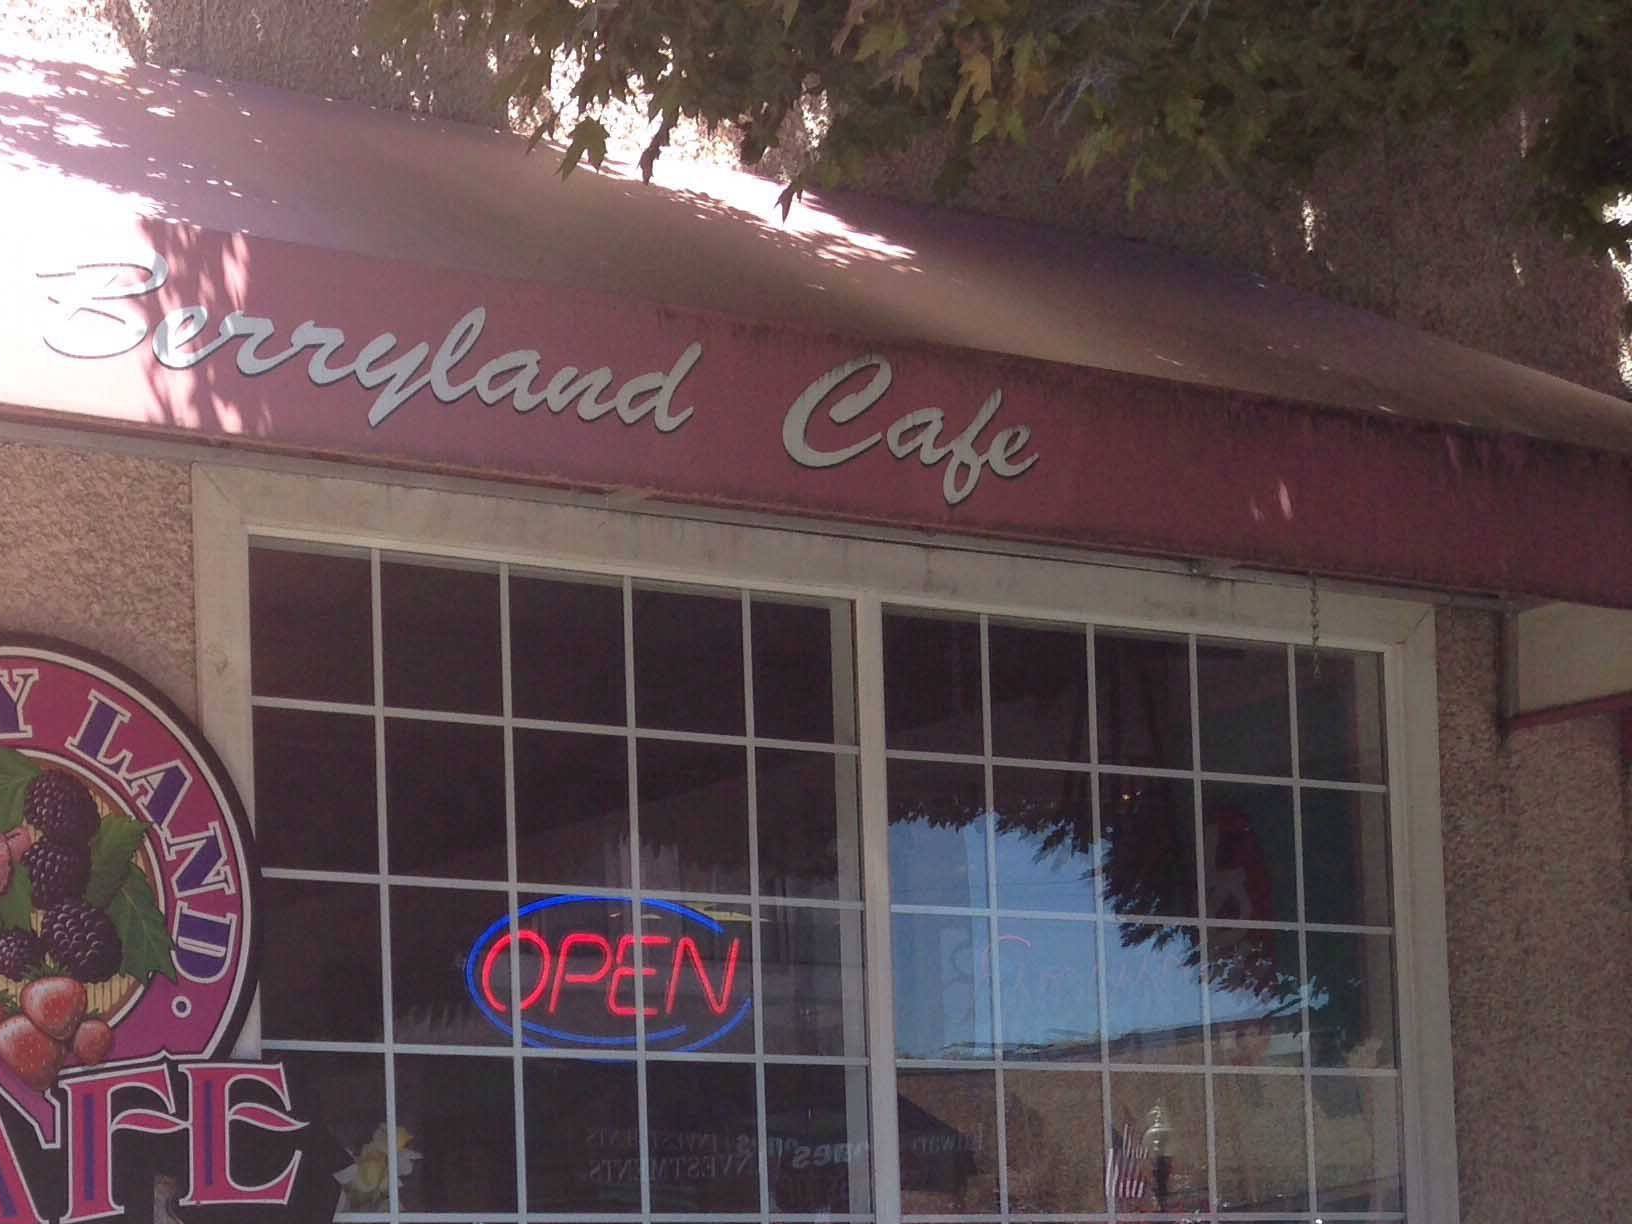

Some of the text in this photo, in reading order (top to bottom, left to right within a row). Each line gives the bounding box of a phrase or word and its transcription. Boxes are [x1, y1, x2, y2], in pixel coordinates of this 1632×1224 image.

[35, 251, 703, 433] Berryland
[65, 690, 236, 985] LAND
[482, 929, 740, 1016] OPEN
